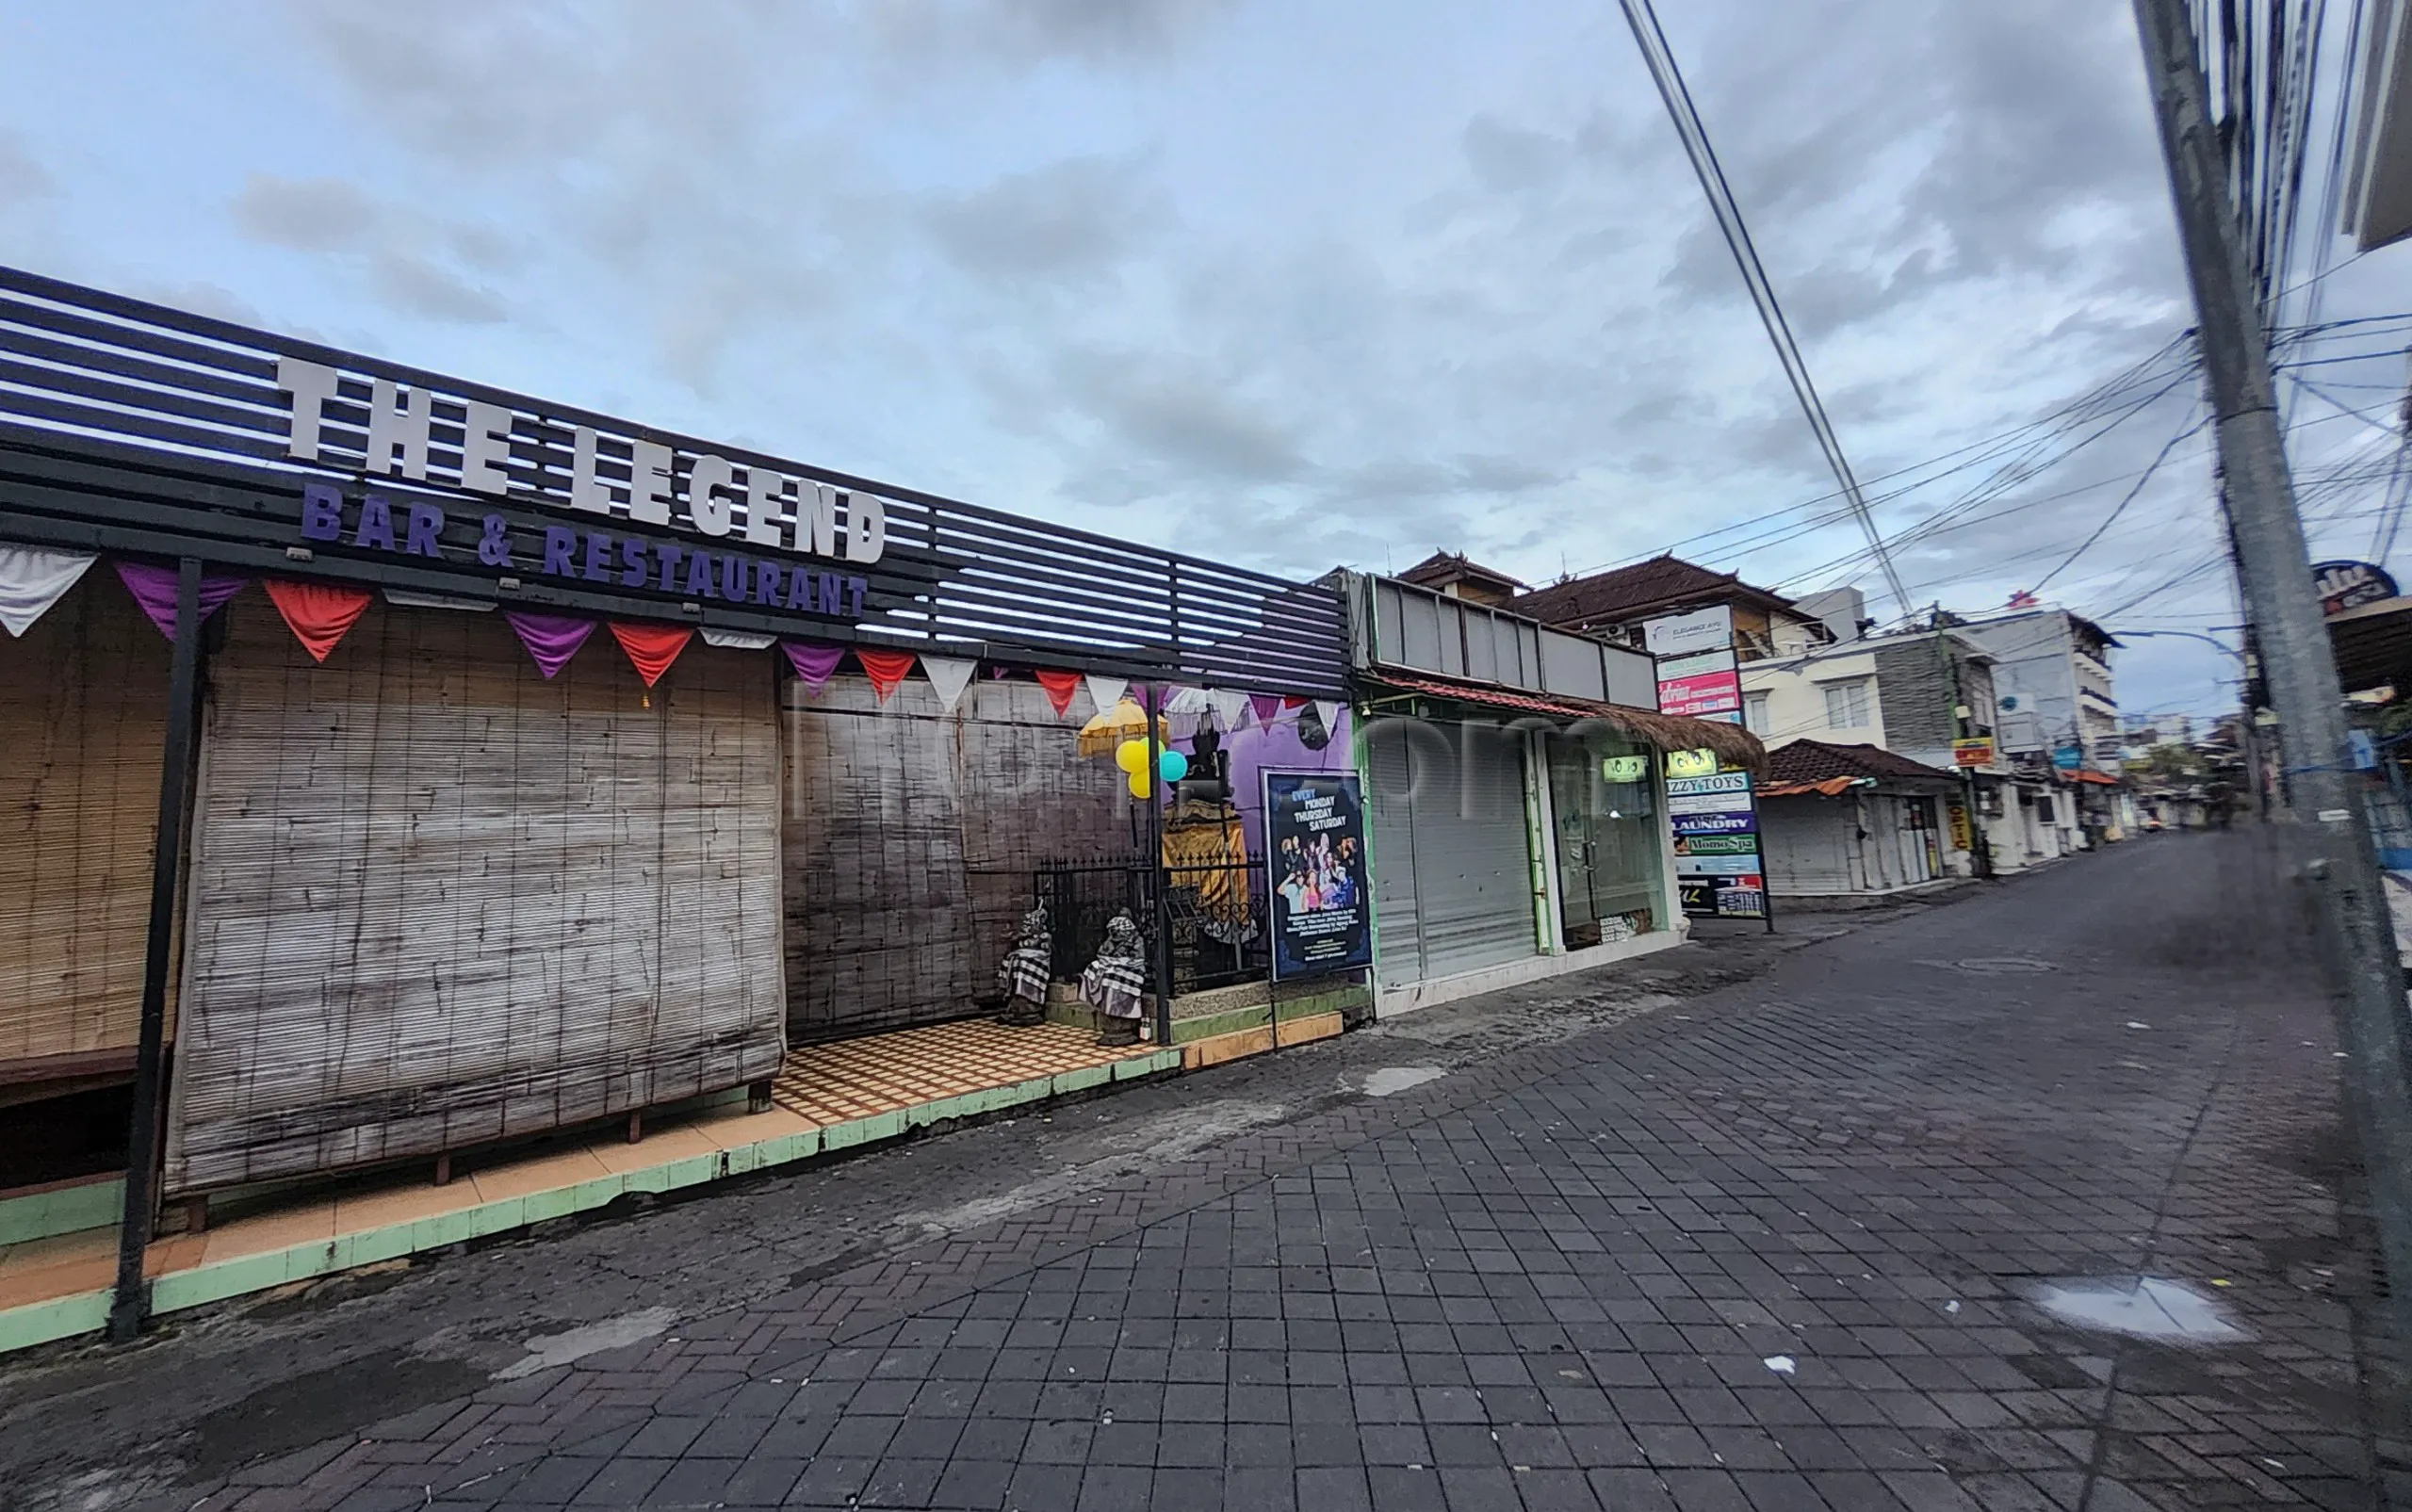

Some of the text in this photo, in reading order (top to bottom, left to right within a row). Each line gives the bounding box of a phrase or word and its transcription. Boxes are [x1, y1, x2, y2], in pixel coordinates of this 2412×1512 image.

[277, 357, 886, 565] THE LEGEND
[301, 482, 868, 618] BAR & RESTAURANT
[1702, 775, 1743, 790] TOYS
[1292, 789, 1316, 803] EVERY
[1304, 795, 1335, 810] MONDAY
[1294, 807, 1332, 823] THURSDAY
[1309, 815, 1346, 832] SATURDAY
[1670, 819, 1749, 830] LAUNDRY
[1690, 836, 1753, 852] Momo Spa
